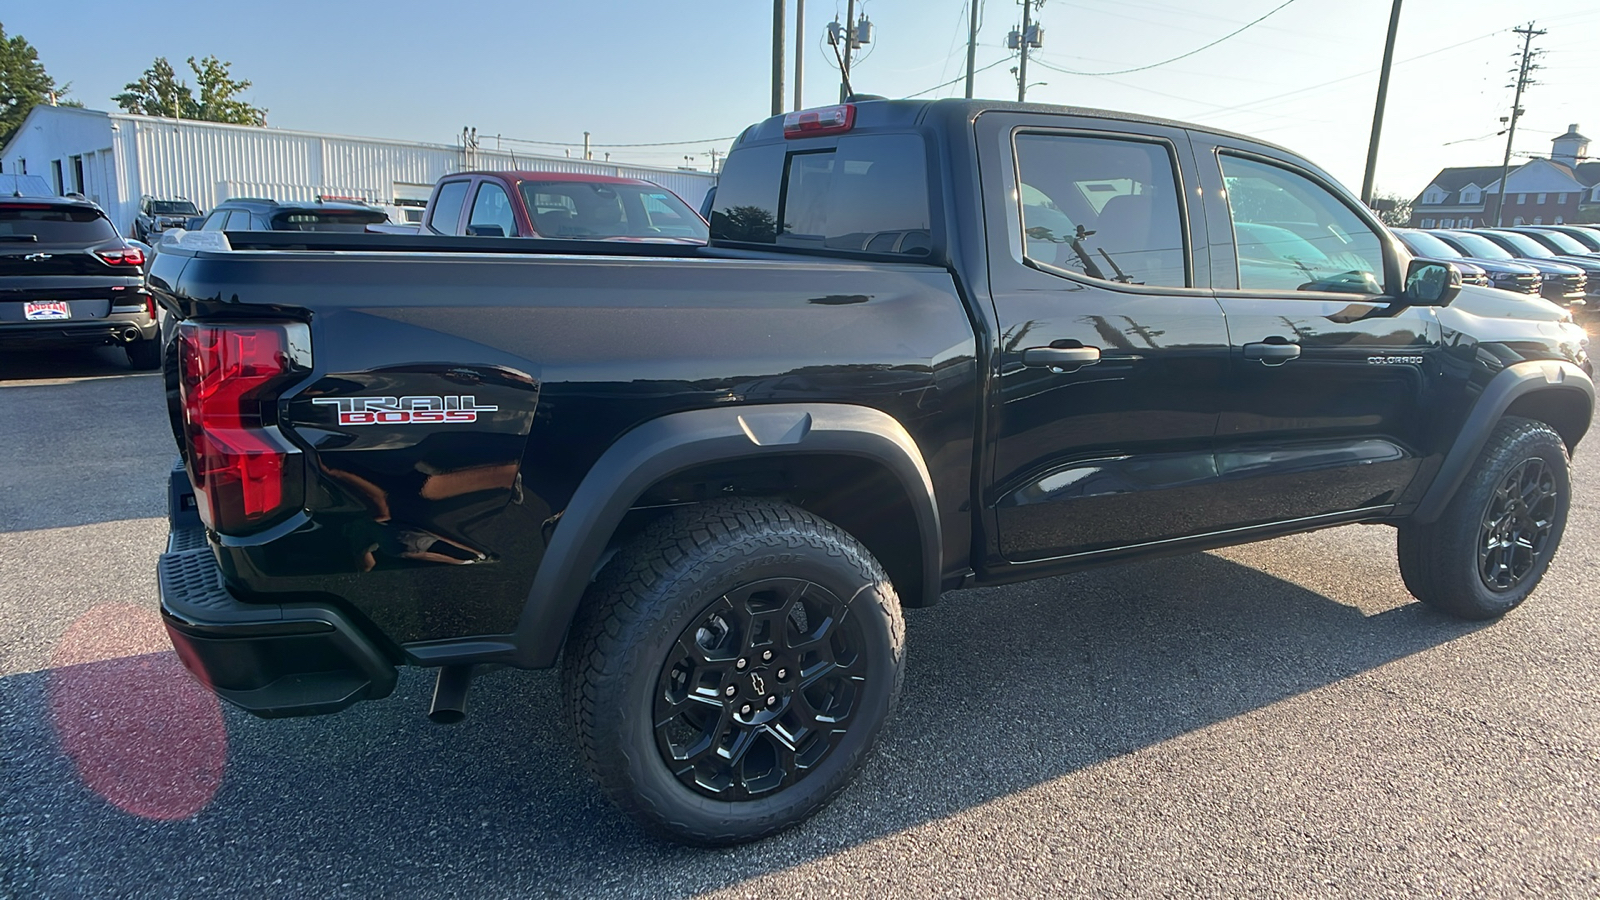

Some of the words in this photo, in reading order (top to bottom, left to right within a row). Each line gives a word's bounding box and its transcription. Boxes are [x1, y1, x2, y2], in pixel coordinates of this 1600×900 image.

[1367, 356, 1423, 364] COLORADO
[312, 395, 498, 412] TRAIL
[339, 410, 477, 426] BOSS
